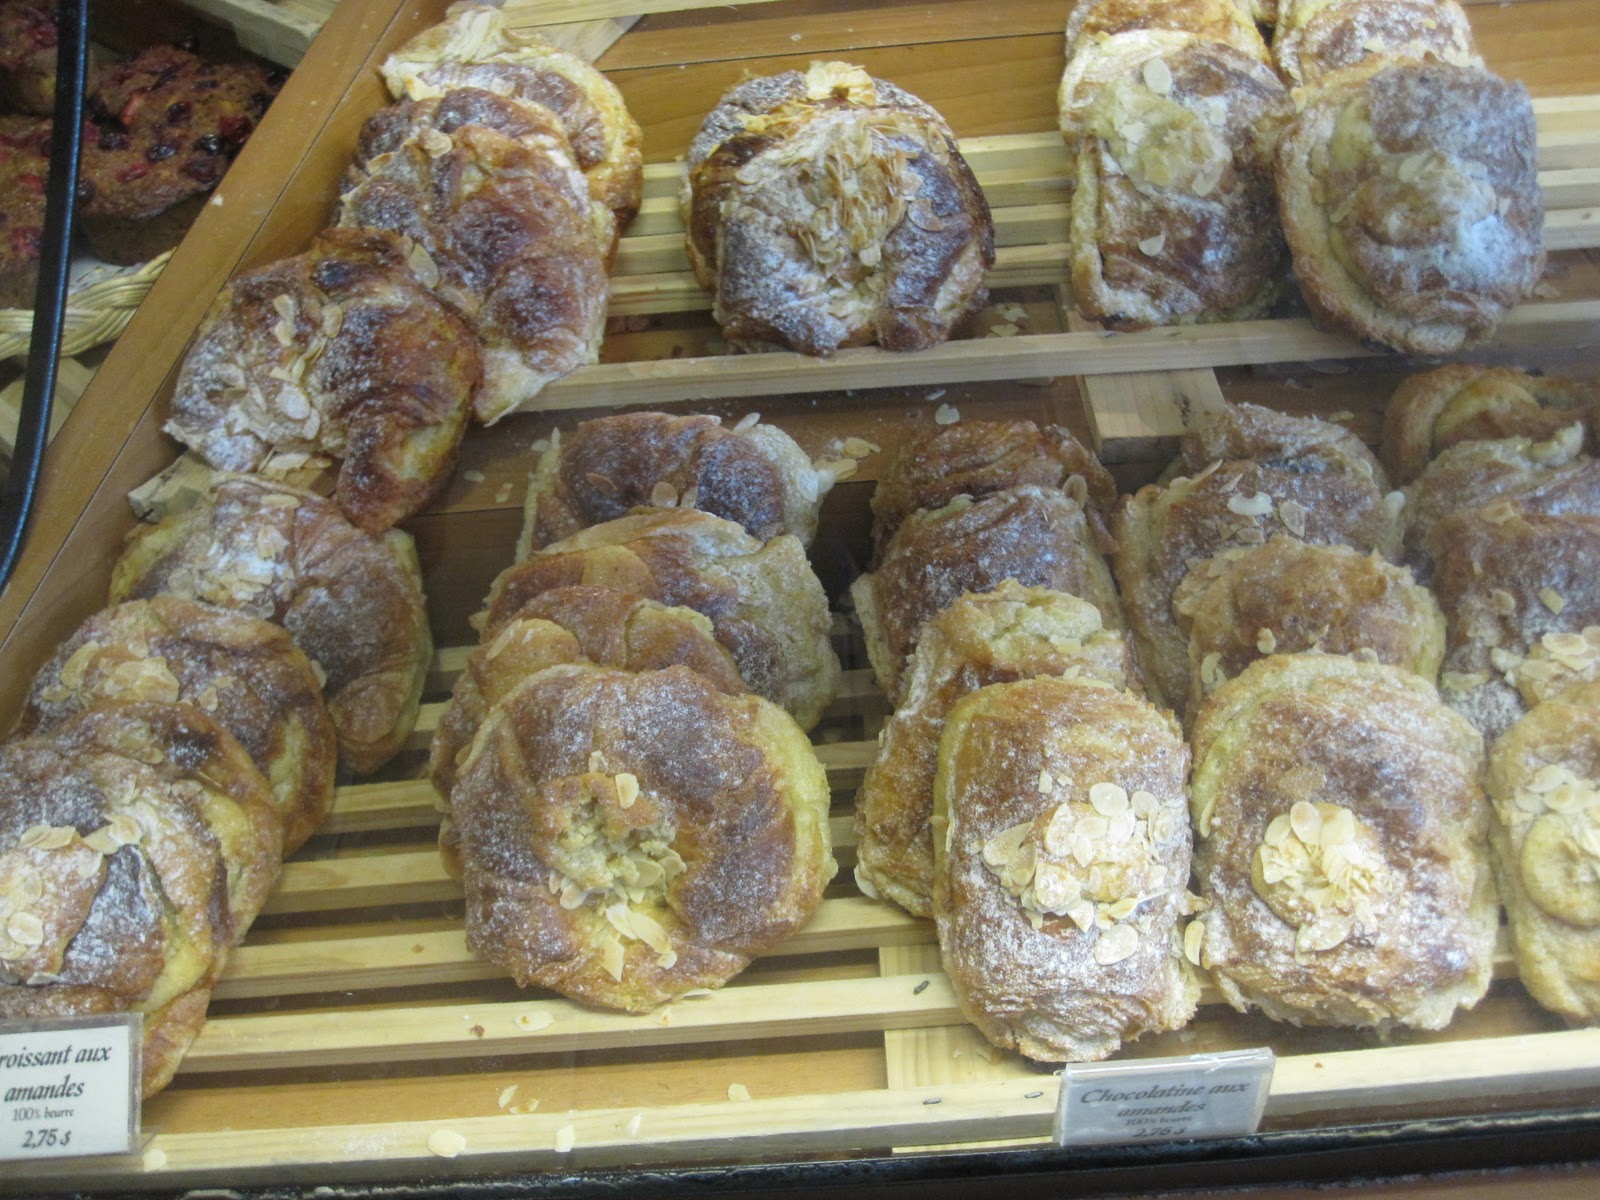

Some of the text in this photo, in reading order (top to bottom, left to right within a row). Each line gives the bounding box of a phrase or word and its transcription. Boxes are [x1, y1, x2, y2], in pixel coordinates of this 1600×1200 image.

[74, 1046, 112, 1063] aux
[4, 1074, 85, 1102] amandes
[1080, 1081, 1251, 1104] Chocolatine aux
[44, 1107, 74, 1118] beurre
[1116, 1100, 1206, 1117] amandes
[22, 1128, 72, 1148] 2,75 $
